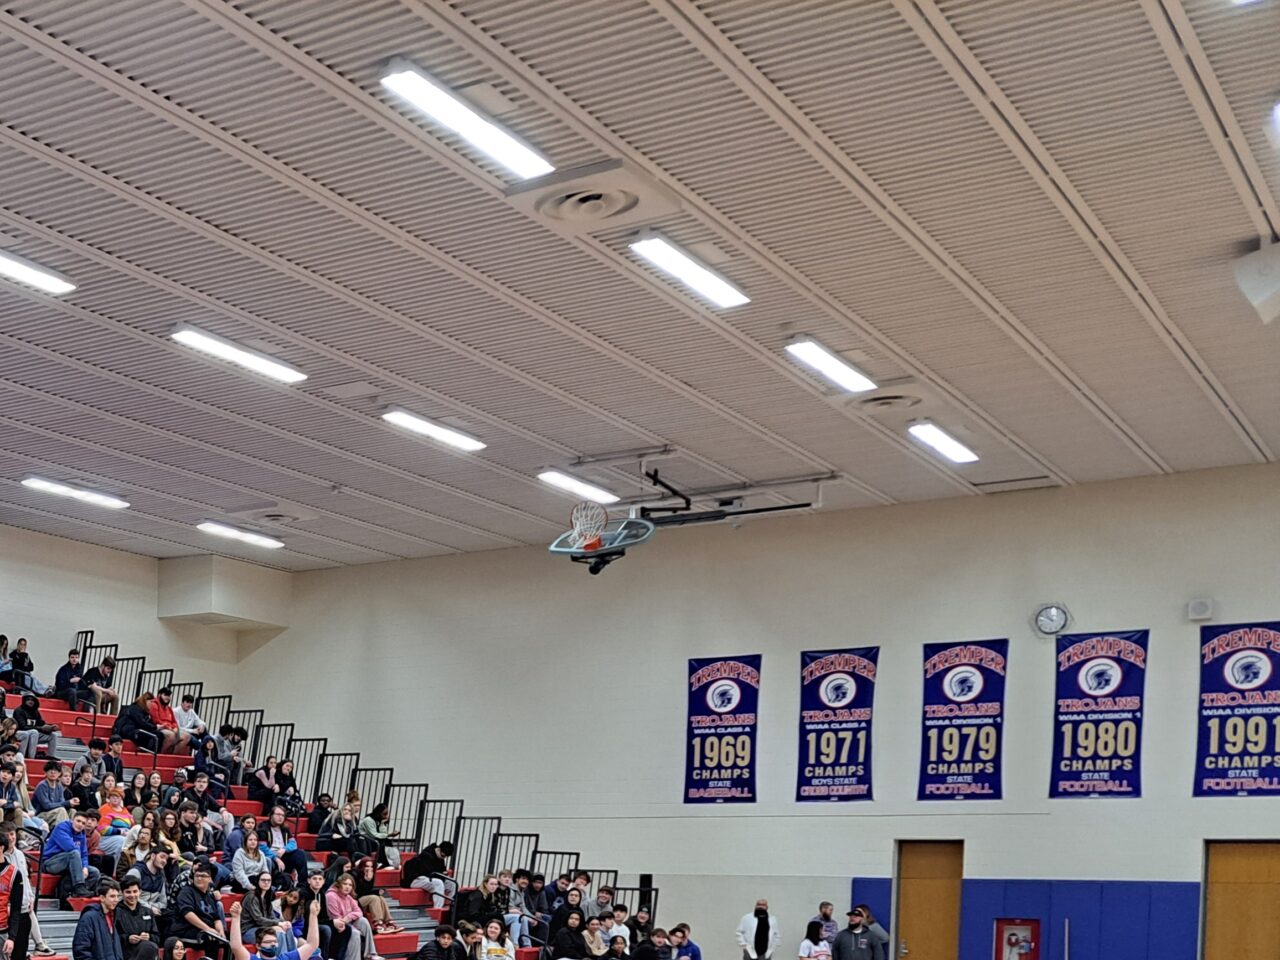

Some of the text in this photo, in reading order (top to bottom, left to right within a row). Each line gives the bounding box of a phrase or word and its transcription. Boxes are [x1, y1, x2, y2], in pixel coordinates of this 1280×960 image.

[1202, 627, 1280, 664] TREMPE
[924, 645, 1006, 678] TREMPER
[1057, 636, 1146, 672] TREMPER
[690, 661, 759, 691] TREMPER
[802, 653, 877, 685] TREMPER
[1057, 696, 1140, 712] TROJANS
[1201, 690, 1280, 707] TROJAN
[802, 707, 872, 722] TROJANS
[924, 702, 1000, 717] TROJANS
[1087, 712, 1132, 720] DIVISION
[1202, 708, 1232, 716] WIAA
[690, 713, 755, 727] TROJANS
[1061, 720, 1136, 758] 1980
[1207, 715, 1280, 754] 1991
[692, 735, 751, 768] 1969
[806, 730, 867, 764] 1971
[927, 726, 997, 762] 1979
[804, 765, 864, 777] CHAMPS
[927, 762, 994, 775] CHAMPS
[1060, 758, 1133, 772] CHAMPS
[692, 768, 750, 780] CHAMPS
[946, 775, 973, 783] STATE
[1081, 772, 1110, 780] STATE
[1228, 769, 1259, 777] STATE
[925, 783, 994, 794] FOOTBALL
[1058, 780, 1133, 792] FOOTBALL
[1202, 777, 1280, 790] FOOTBALL
